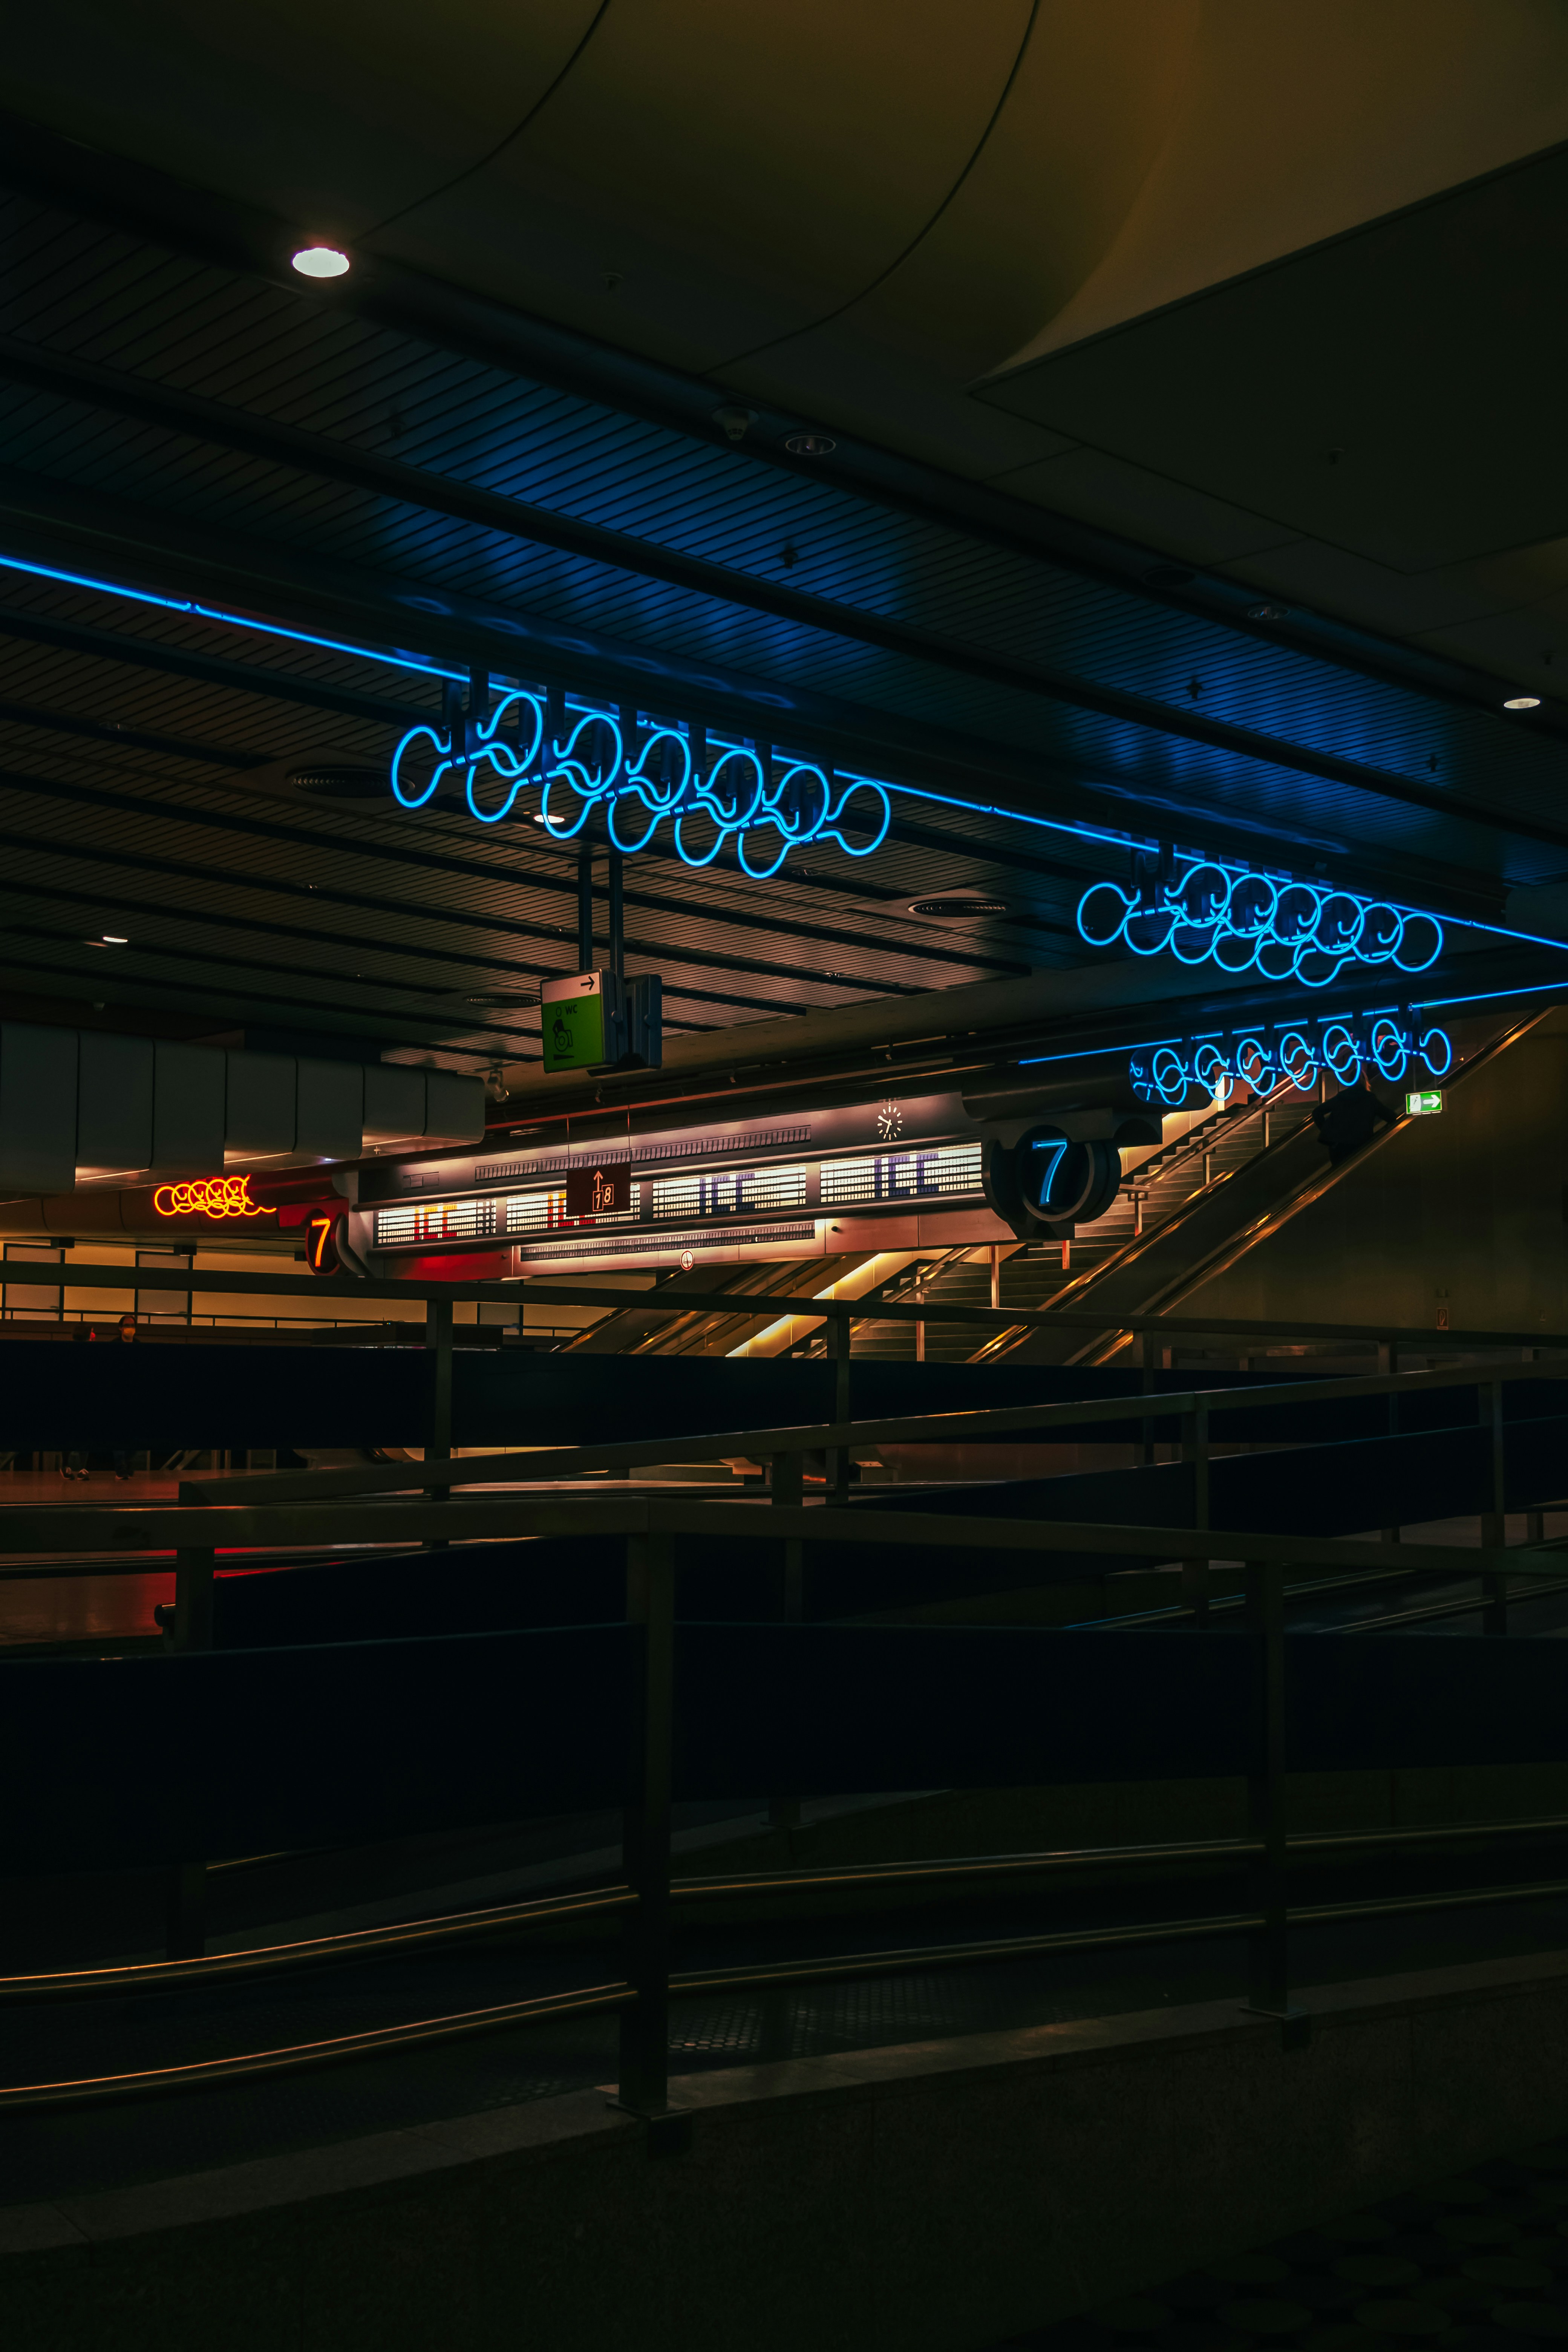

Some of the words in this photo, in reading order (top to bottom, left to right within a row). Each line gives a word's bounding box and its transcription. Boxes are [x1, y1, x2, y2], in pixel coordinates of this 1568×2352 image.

[565, 1004, 577, 1015] WC
[1031, 1138, 1068, 1206] 7
[596, 1193, 601, 1208] 1
[604, 1187, 611, 1203] 8
[312, 1218, 331, 1267] 7
